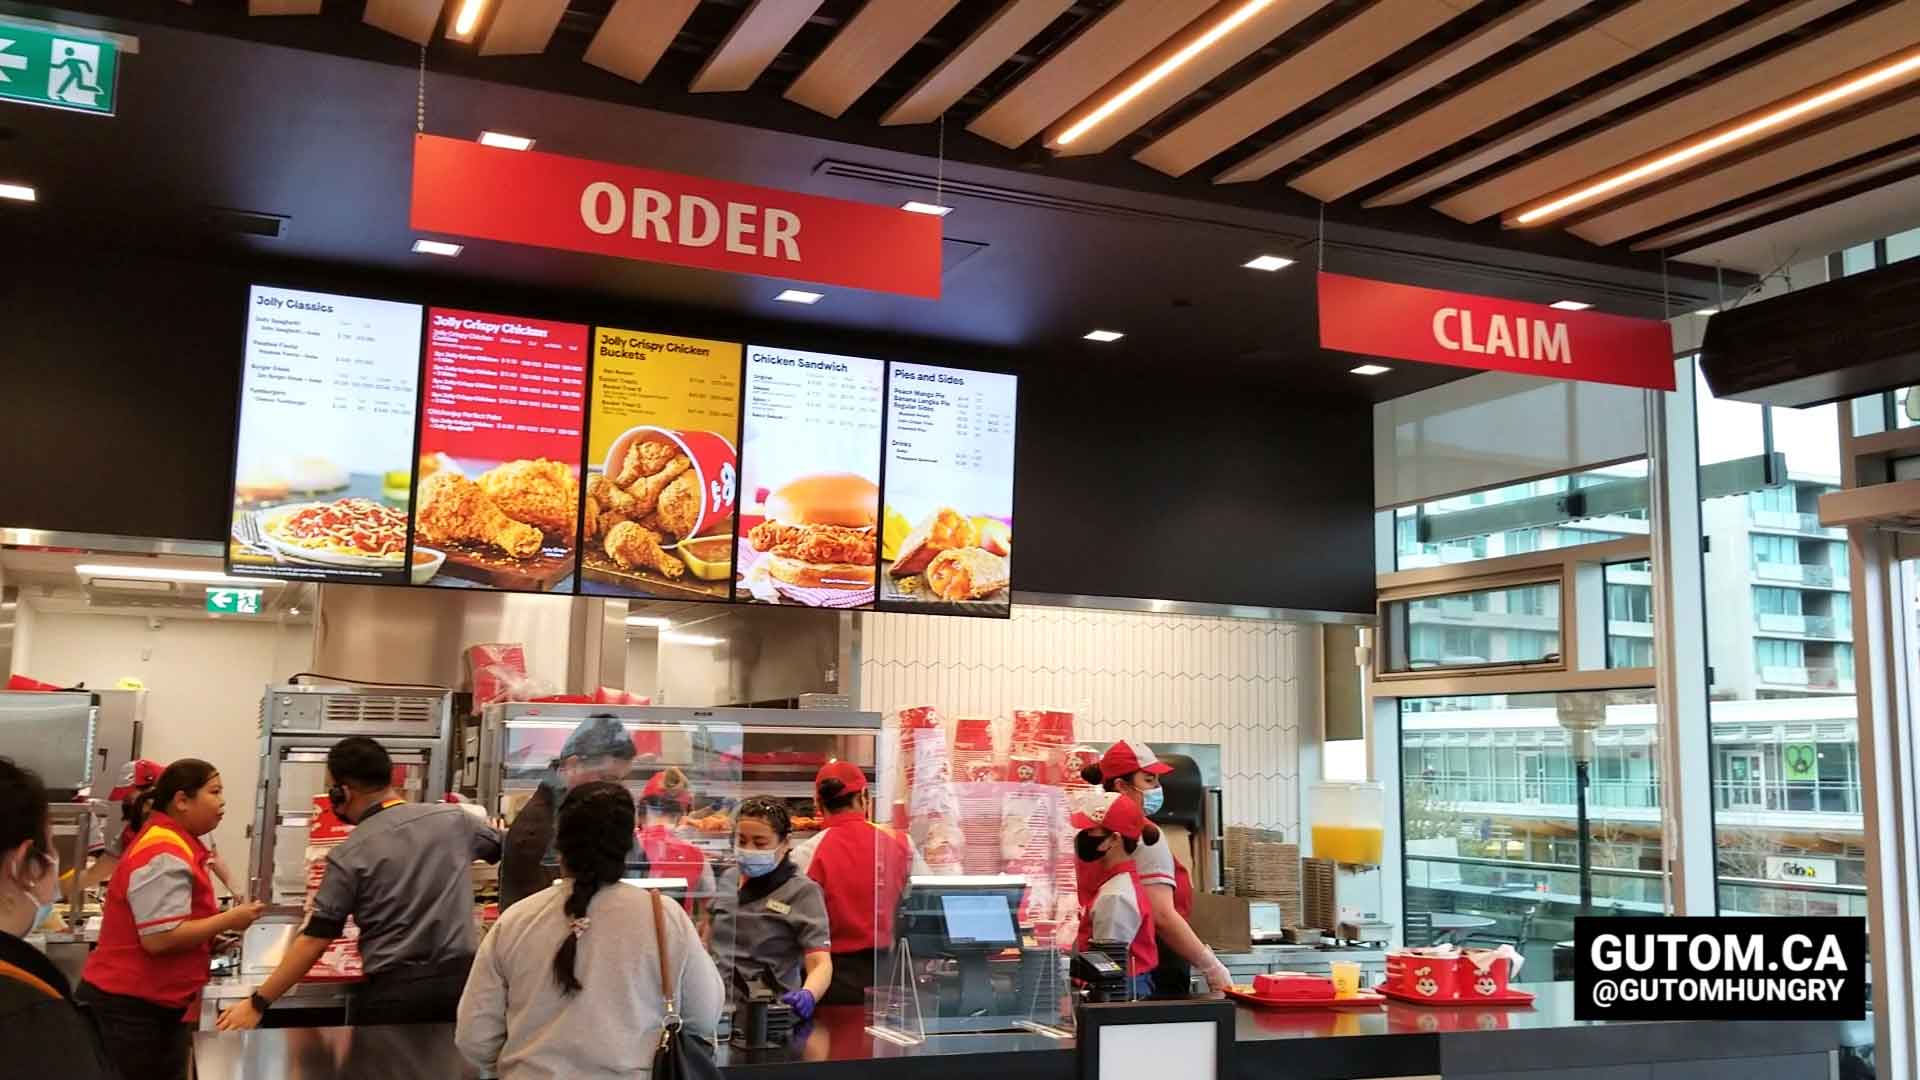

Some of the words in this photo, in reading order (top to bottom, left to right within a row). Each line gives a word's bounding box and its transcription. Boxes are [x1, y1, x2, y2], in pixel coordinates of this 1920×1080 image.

[579, 181, 801, 262] ORDER
[256, 296, 283, 309] Jolly
[286, 299, 334, 313] Classics
[433, 315, 461, 329] Jolly
[463, 319, 500, 334] Crispy
[501, 324, 549, 337] Chicken
[1432, 307, 1573, 364] CLAIM
[600, 347, 646, 361] Buckets
[601, 335, 627, 348] Jolly
[629, 338, 664, 353] Crispy
[666, 343, 711, 357] Chicken
[753, 354, 795, 367] Chicken
[798, 359, 848, 373] Sandwich
[895, 369, 915, 380] Pies
[917, 373, 936, 382] and
[938, 374, 965, 385] Sides
